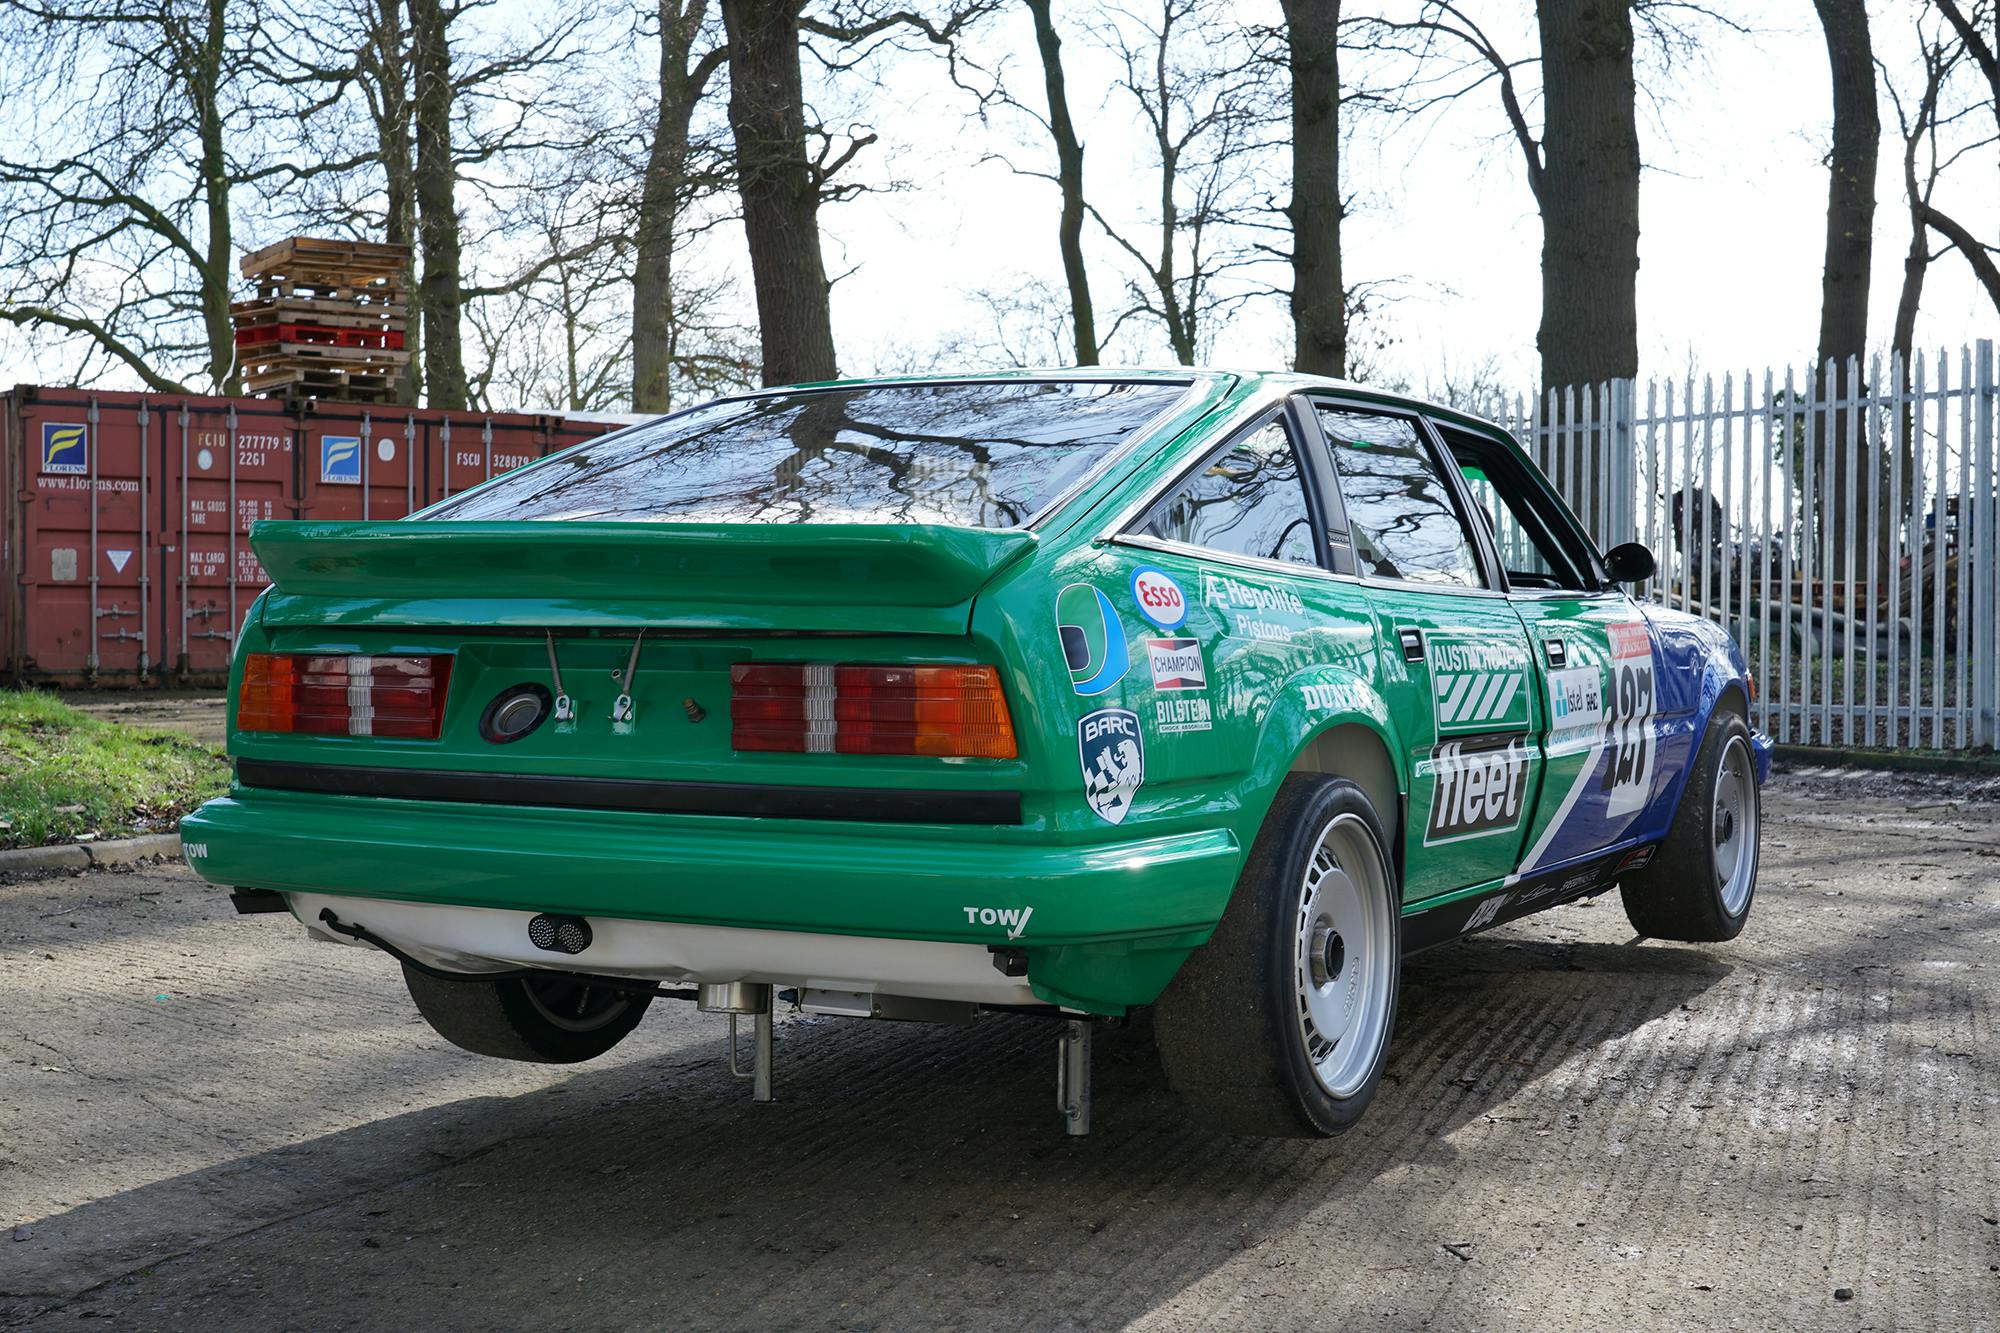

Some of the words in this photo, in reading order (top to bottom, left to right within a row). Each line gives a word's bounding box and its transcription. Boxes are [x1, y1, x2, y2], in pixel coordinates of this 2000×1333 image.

[198, 433, 226, 447] FCIU
[239, 435, 280, 450] 277779
[284, 435, 291, 450] 3
[239, 452, 265, 466] 22G1
[456, 453, 480, 466] FSCU
[44, 464, 86, 472] FLORENS
[37, 476, 139, 491] www.florns.com
[207, 501, 226, 512] GROSS
[191, 513, 206, 525] TARE
[205, 552, 225, 563] CARGO
[1222, 577, 1304, 615] Hepolite
[1236, 614, 1292, 642] Pistons
[1154, 654, 1200, 674] CHAMPION
[1155, 698, 1211, 723] BILSTEIN
[1084, 716, 1136, 743] BARC
[1435, 738, 1523, 830] fleet
[963, 907, 1020, 926] TOW
